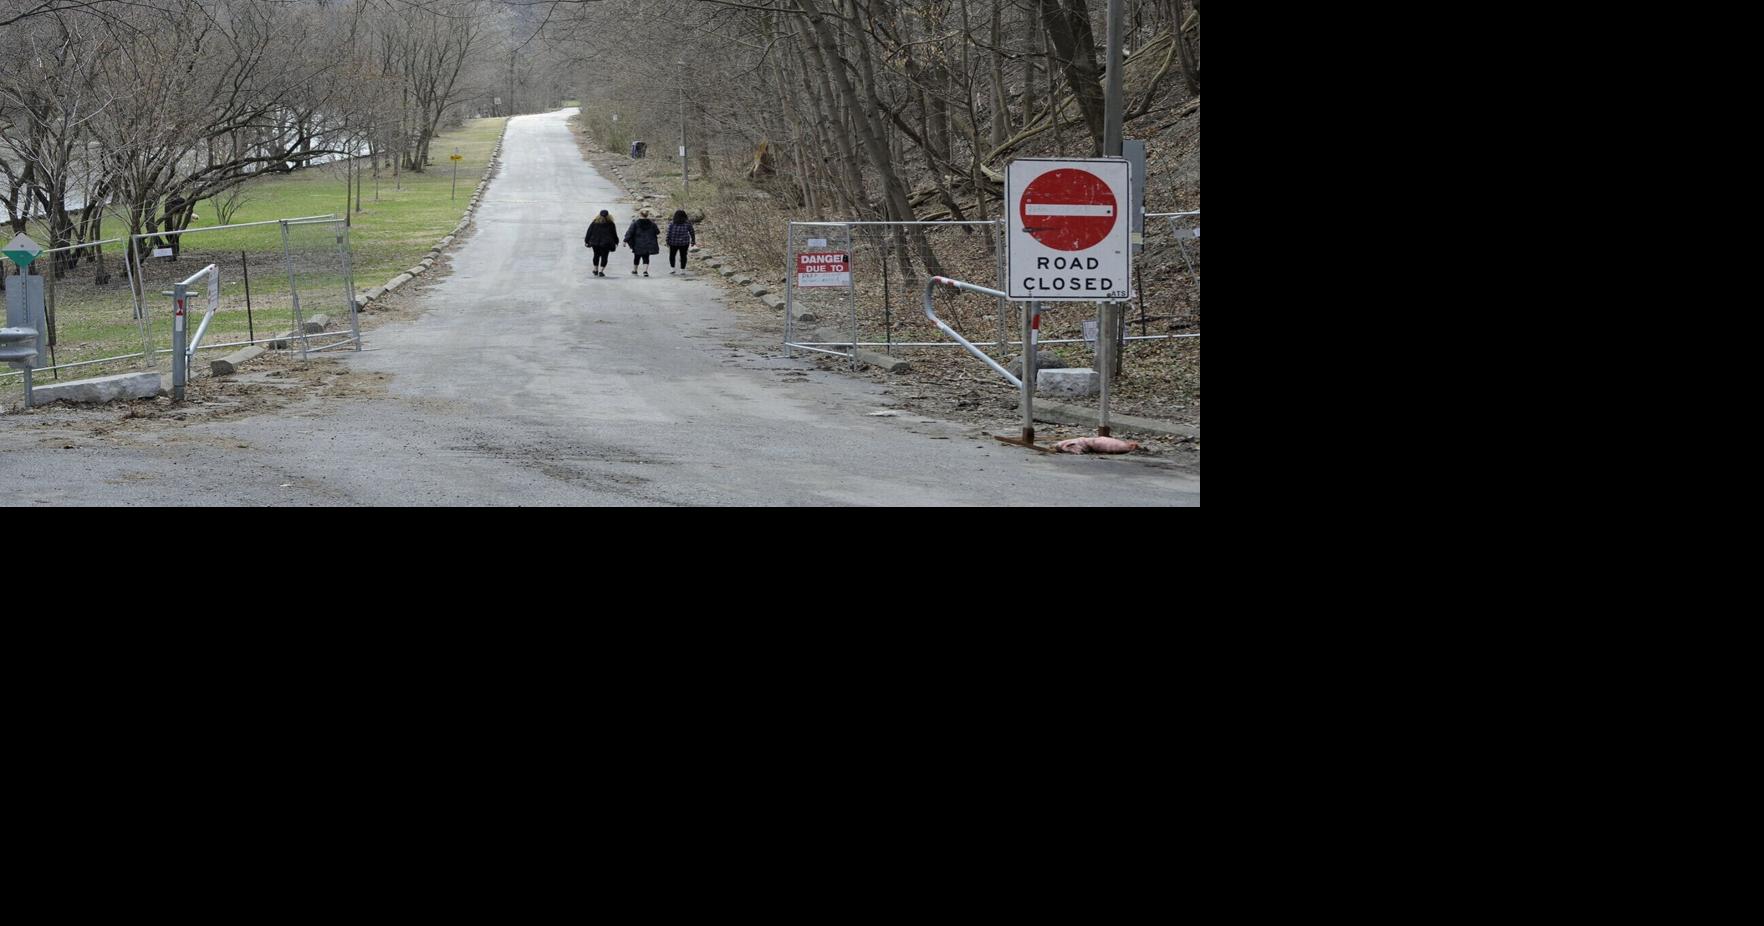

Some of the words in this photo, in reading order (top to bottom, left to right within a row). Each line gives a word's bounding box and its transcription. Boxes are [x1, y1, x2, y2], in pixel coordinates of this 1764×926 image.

[830, 264, 844, 272] TO
[1037, 257, 1099, 270] ROAD
[1023, 277, 1113, 291] CLOSED
